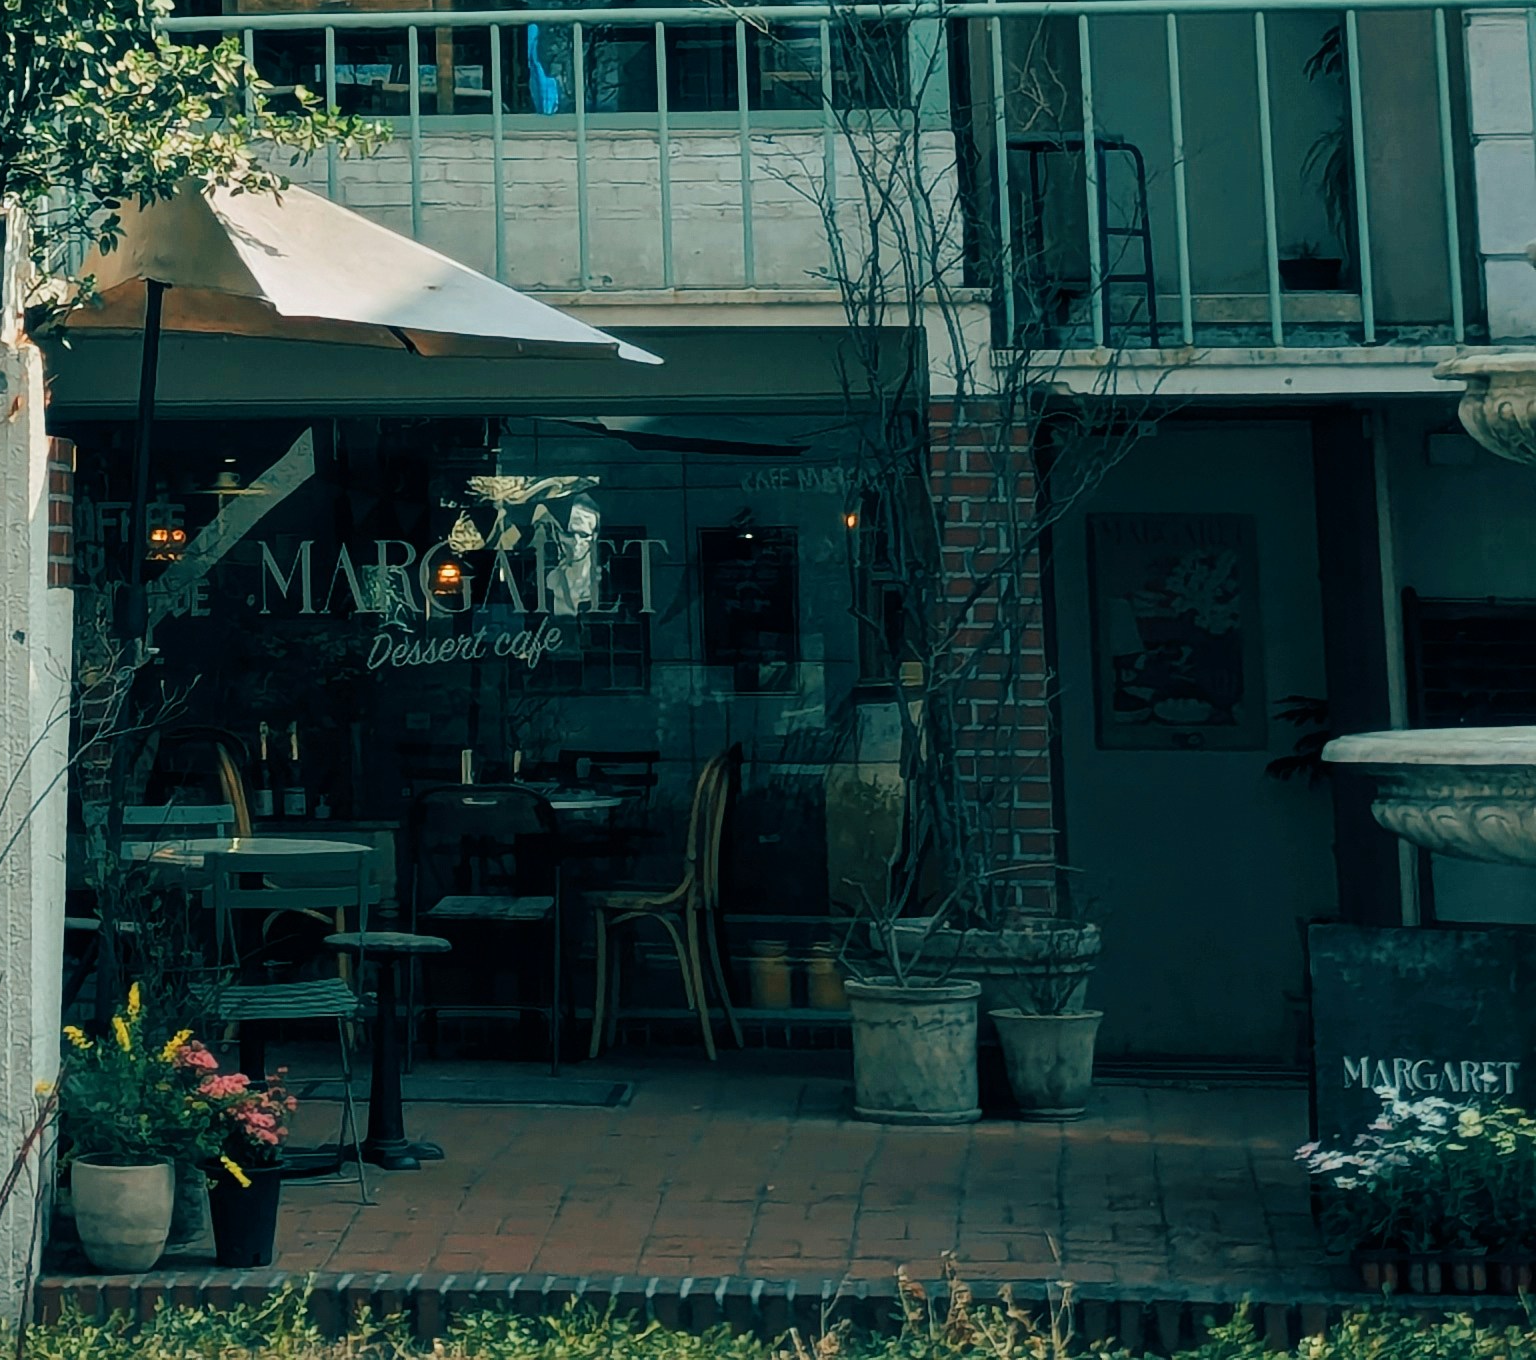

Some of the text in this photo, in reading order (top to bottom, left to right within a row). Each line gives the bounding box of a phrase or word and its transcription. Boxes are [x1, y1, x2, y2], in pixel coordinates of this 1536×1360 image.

[366, 616, 563, 670] Dessert cafe
[1342, 1055, 1521, 1095] MARGARET
